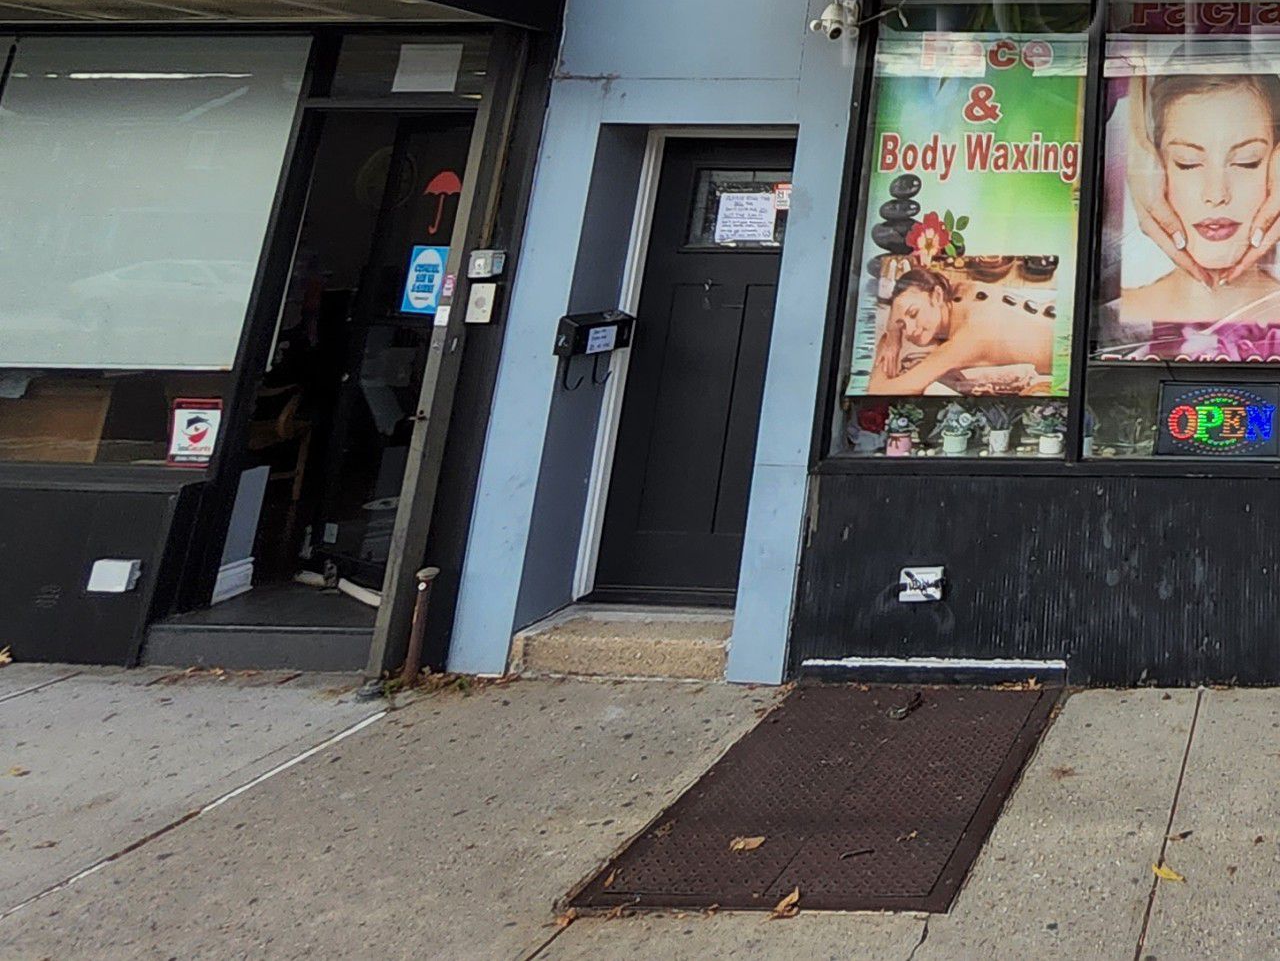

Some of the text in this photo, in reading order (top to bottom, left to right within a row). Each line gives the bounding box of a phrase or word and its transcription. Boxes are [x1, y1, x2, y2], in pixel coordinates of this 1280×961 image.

[921, 31, 1054, 70] Face
[962, 84, 1003, 124] &
[879, 132, 1081, 184] Body Waxing
[1168, 404, 1276, 442] OPEN
